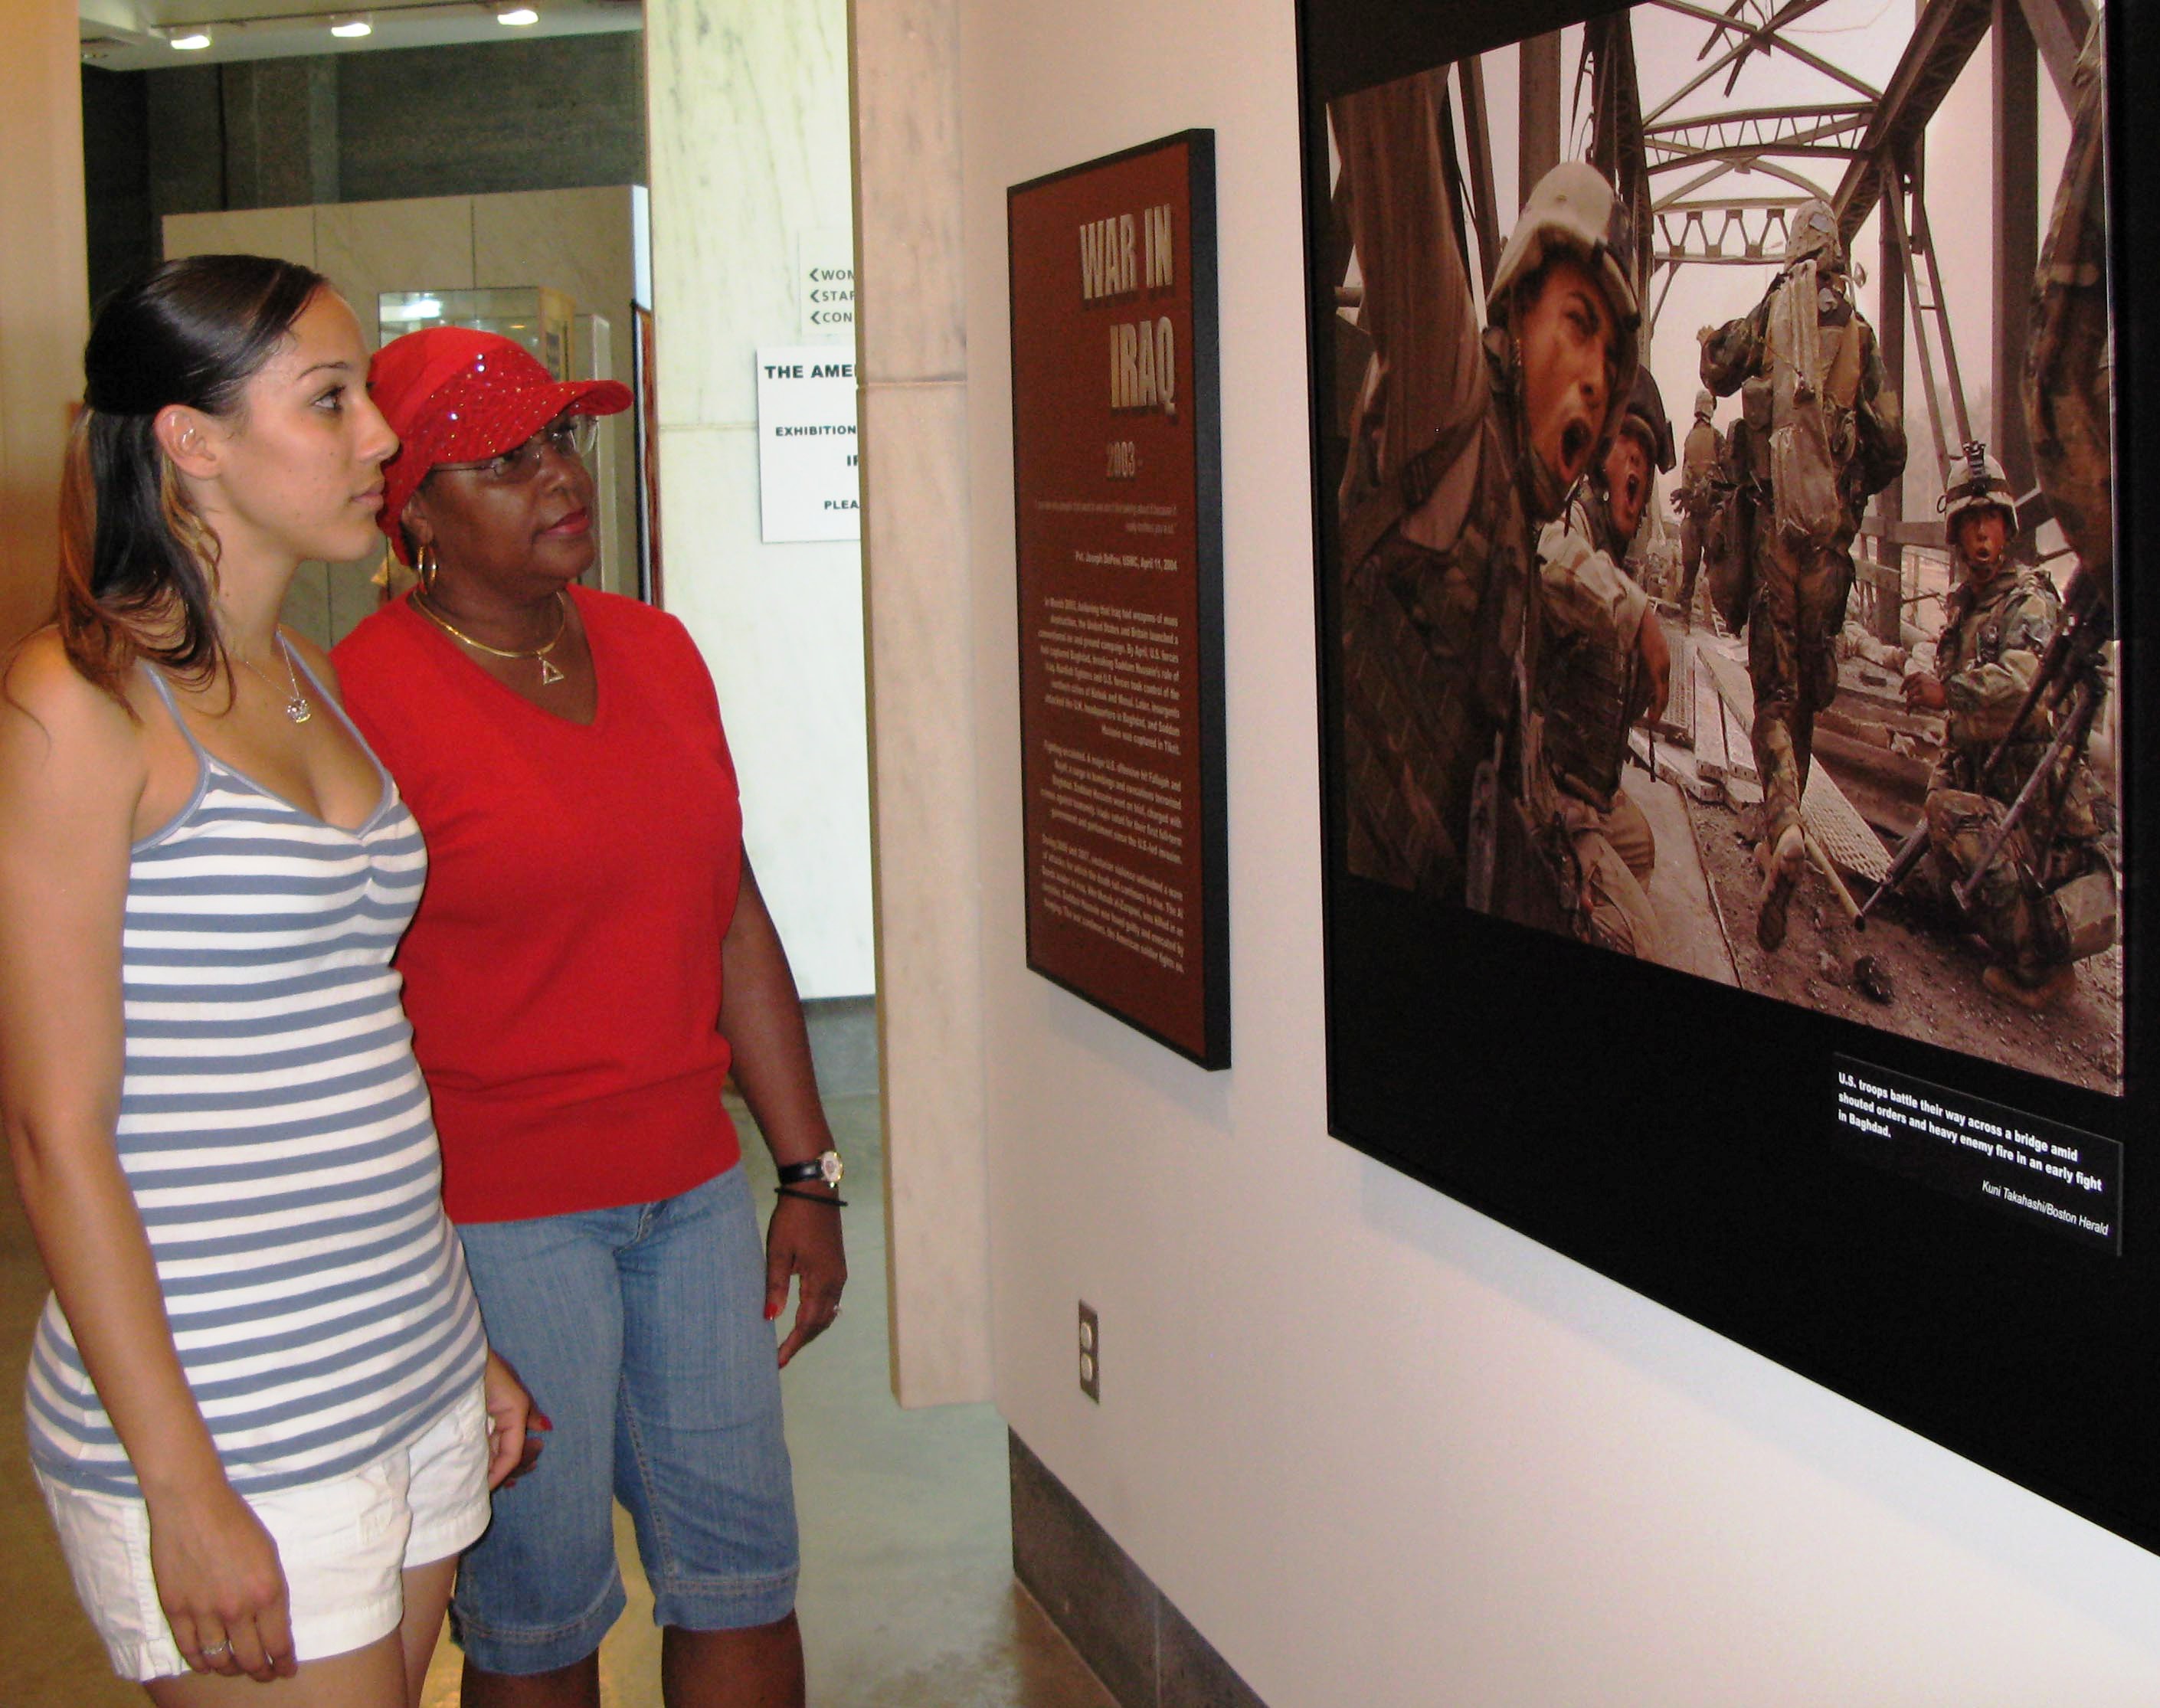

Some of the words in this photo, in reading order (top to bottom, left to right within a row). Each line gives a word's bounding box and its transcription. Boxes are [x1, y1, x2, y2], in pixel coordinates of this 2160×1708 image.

[1079, 214, 1137, 300] WAR
[1144, 203, 1173, 289] IN
[823, 312, 853, 322] CON
[764, 365, 803, 379] THE
[810, 364, 856, 378] AME
[1109, 316, 1176, 416] IRAQ
[776, 425, 856, 437] EXHIBITION
[1838, 1072, 1857, 1088] U.S.
[1859, 1079, 1888, 1099] troops
[1890, 1089, 1918, 1108] battle
[1920, 1100, 1943, 1117] their
[1945, 1110, 1965, 1127] way
[1968, 1117, 2002, 1137] across
[2005, 1130, 2012, 1140] a
[2014, 1130, 2048, 1152] bridge
[2050, 1144, 2078, 1162] amid
[1838, 1109, 1847, 1122] in
[1849, 1113, 1892, 1137] Baghdad.
[1838, 1092, 1874, 1113] shouted
[1877, 1106, 1906, 1124] orders
[1909, 1117, 1926, 1131] and
[1929, 1121, 1958, 1144] heavy
[1959, 1134, 1993, 1156] enemy
[1995, 1144, 2014, 1160] fire
[2017, 1151, 2027, 1166] in
[2029, 1157, 2043, 1171] an
[2045, 1163, 2073, 1183] early
[2076, 1171, 2103, 1192] fight
[1982, 1180, 2001, 1197] Kuni
[2004, 1187, 2077, 1224] Takahashi/Boston
[2078, 1215, 2109, 1235] Herald
